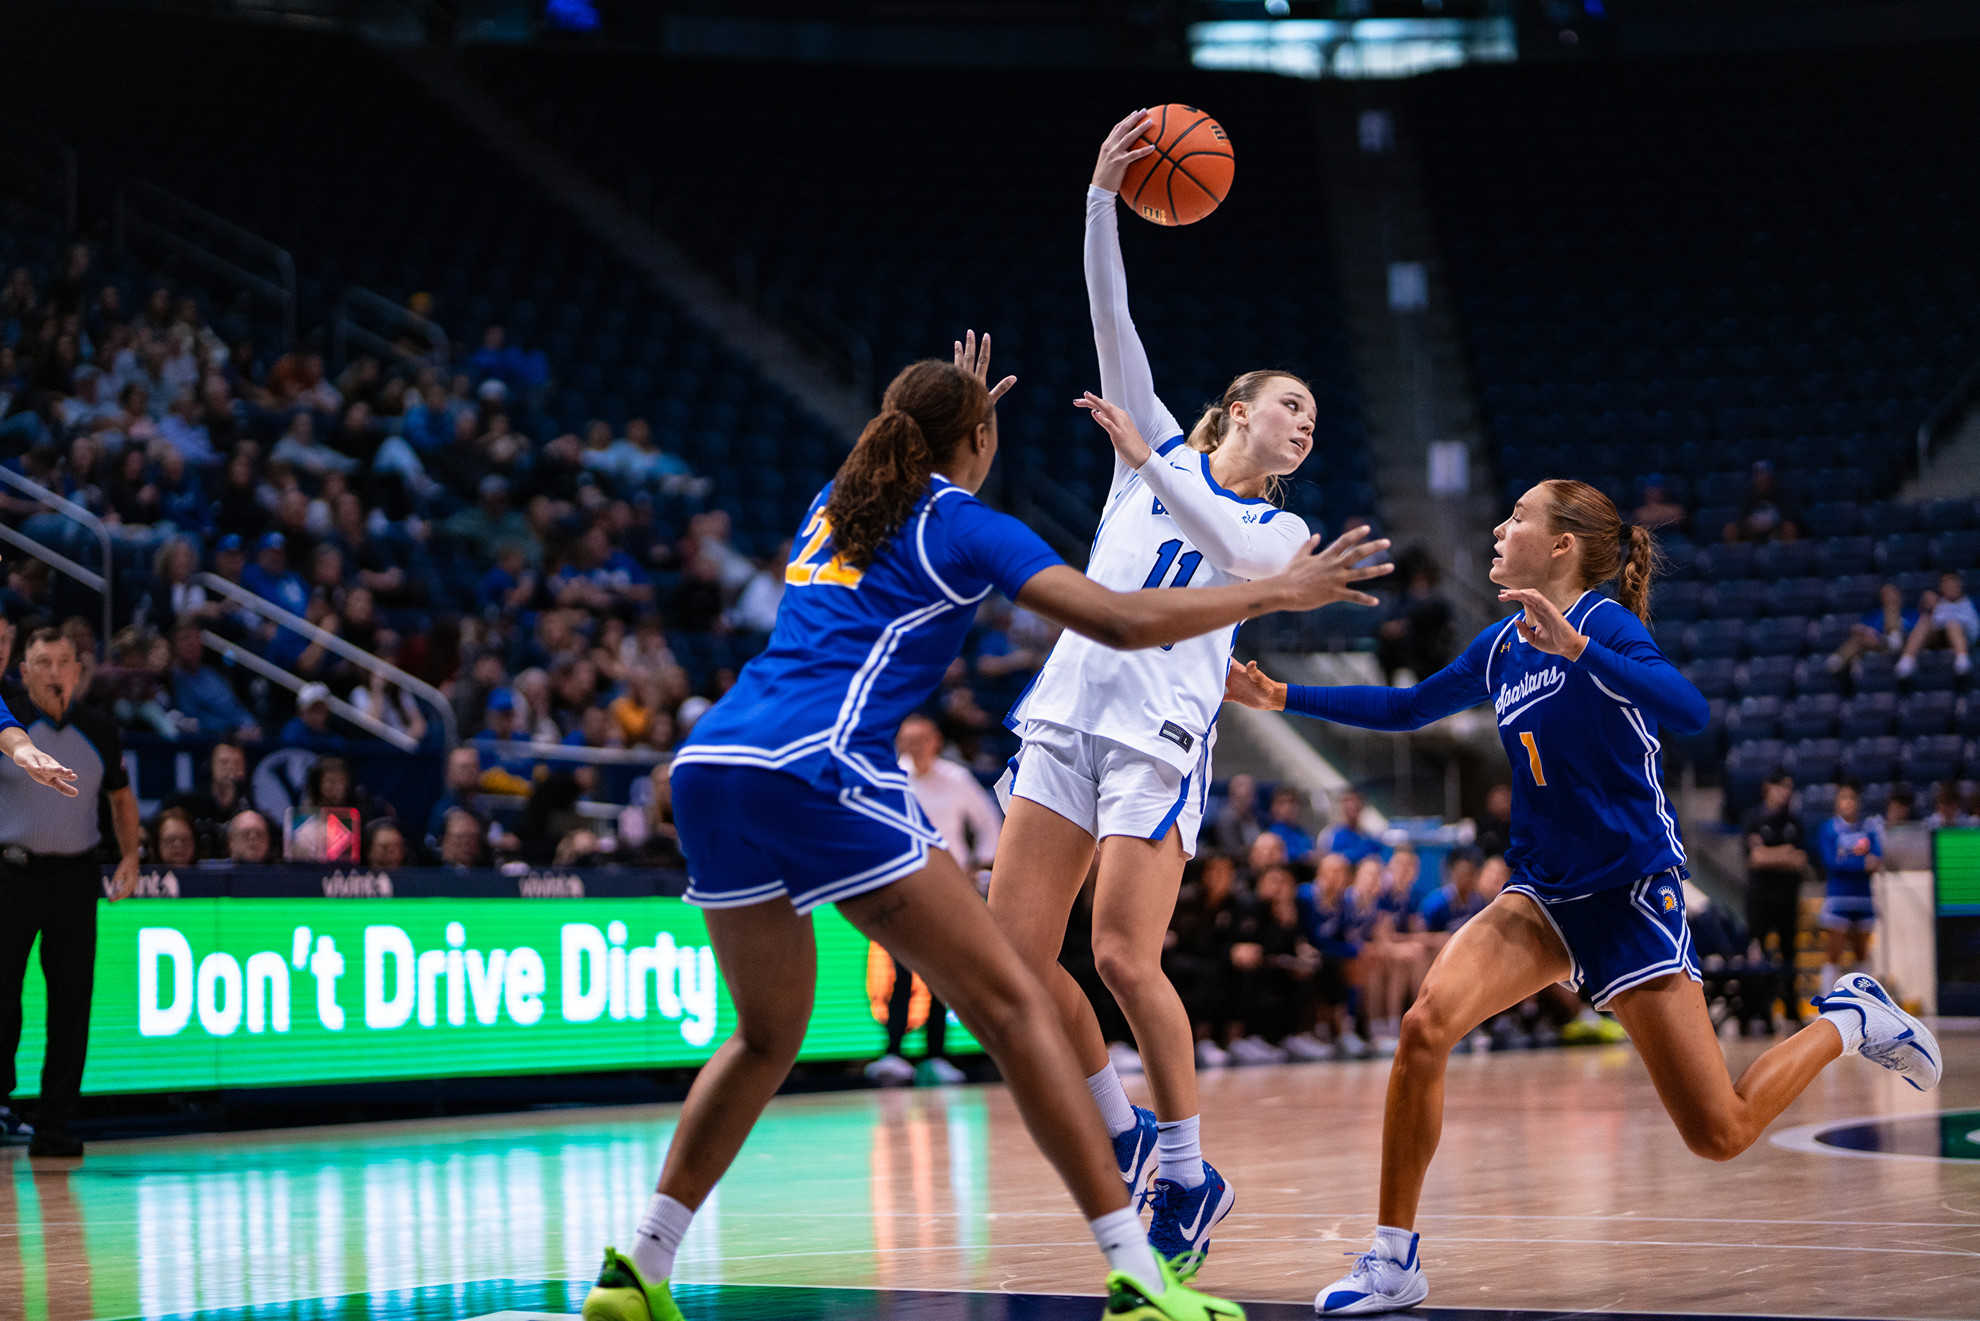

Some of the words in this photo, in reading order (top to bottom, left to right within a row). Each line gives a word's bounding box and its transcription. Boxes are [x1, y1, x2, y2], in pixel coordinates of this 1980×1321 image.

[1495, 666, 1558, 715] Spartans
[1519, 731, 1547, 786] 1
[138, 925, 346, 1037] Don't
[363, 920, 546, 1029] Drive
[560, 919, 717, 1047] Dirty
